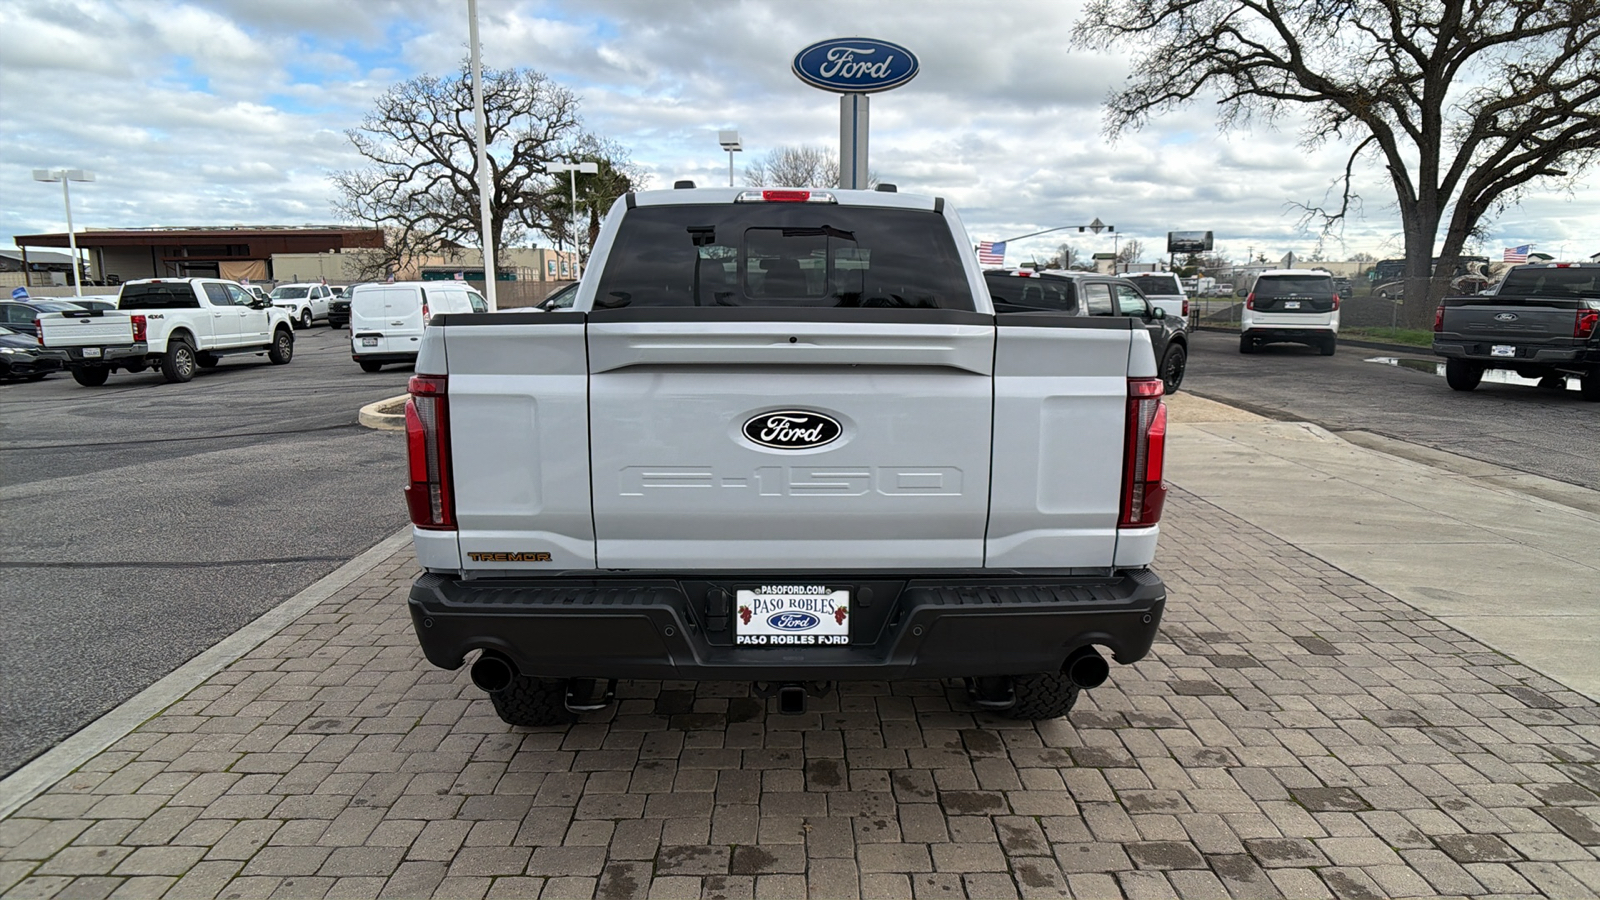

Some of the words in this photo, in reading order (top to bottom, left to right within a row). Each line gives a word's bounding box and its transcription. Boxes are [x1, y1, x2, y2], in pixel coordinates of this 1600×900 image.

[820, 46, 894, 79] Ford
[760, 415, 824, 443] Ford
[618, 465, 964, 497] F-150
[467, 551, 553, 562] TREMOR
[761, 585, 826, 595] PASOFORD.COM
[753, 598, 784, 615] PASO
[788, 598, 835, 615] ROBLES
[777, 614, 810, 628] Ford
[736, 635, 767, 645] PASO
[770, 635, 815, 645] ROBLES
[818, 635, 849, 645] FORD
